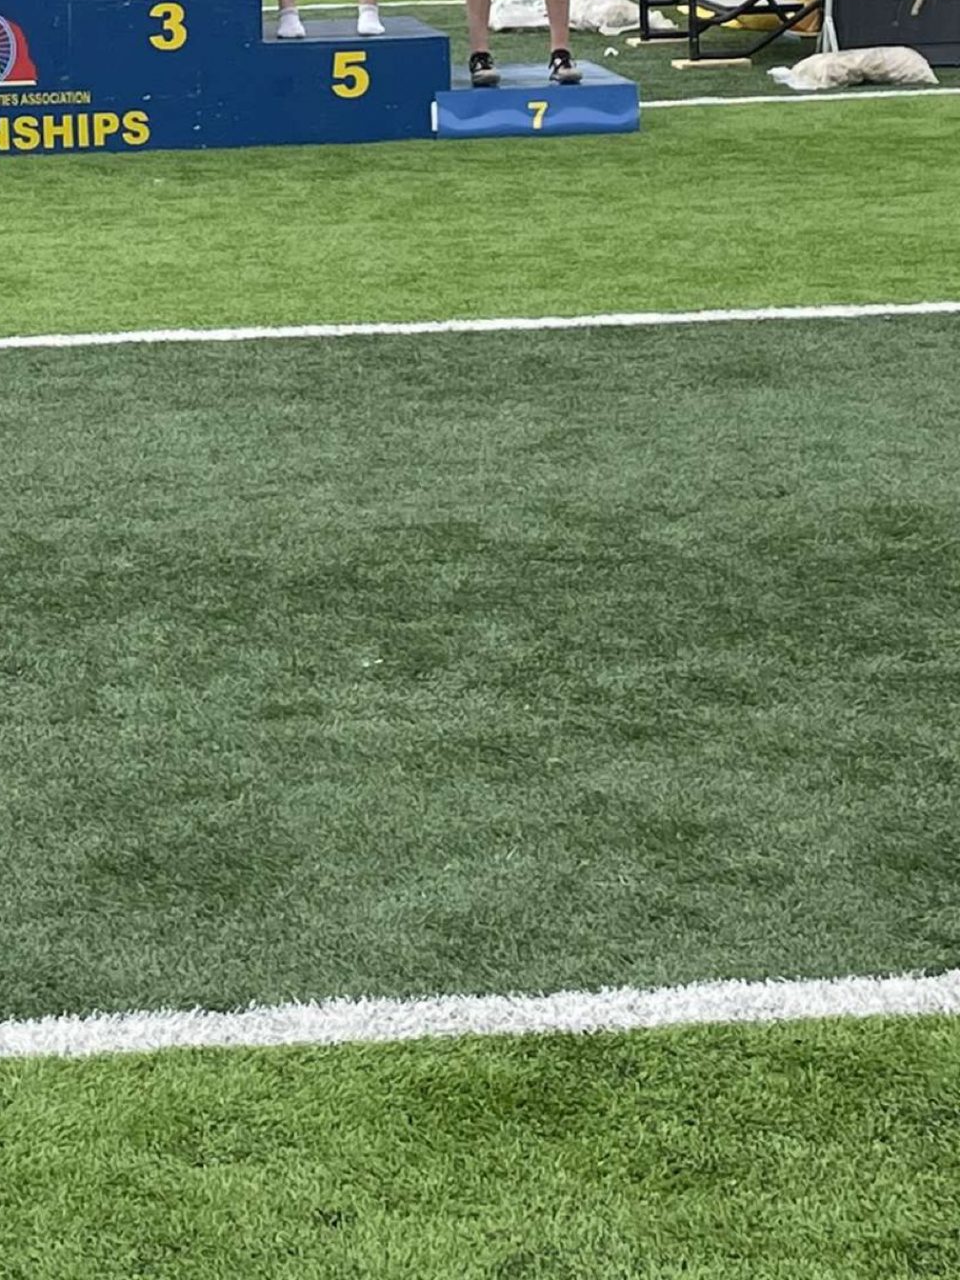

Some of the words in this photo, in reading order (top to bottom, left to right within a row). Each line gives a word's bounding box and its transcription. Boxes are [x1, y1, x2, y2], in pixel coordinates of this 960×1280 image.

[149, 1, 188, 51] 3
[331, 50, 370, 99] 5
[20, 90, 92, 105] ASSOCIATION
[527, 101, 549, 130] 7
